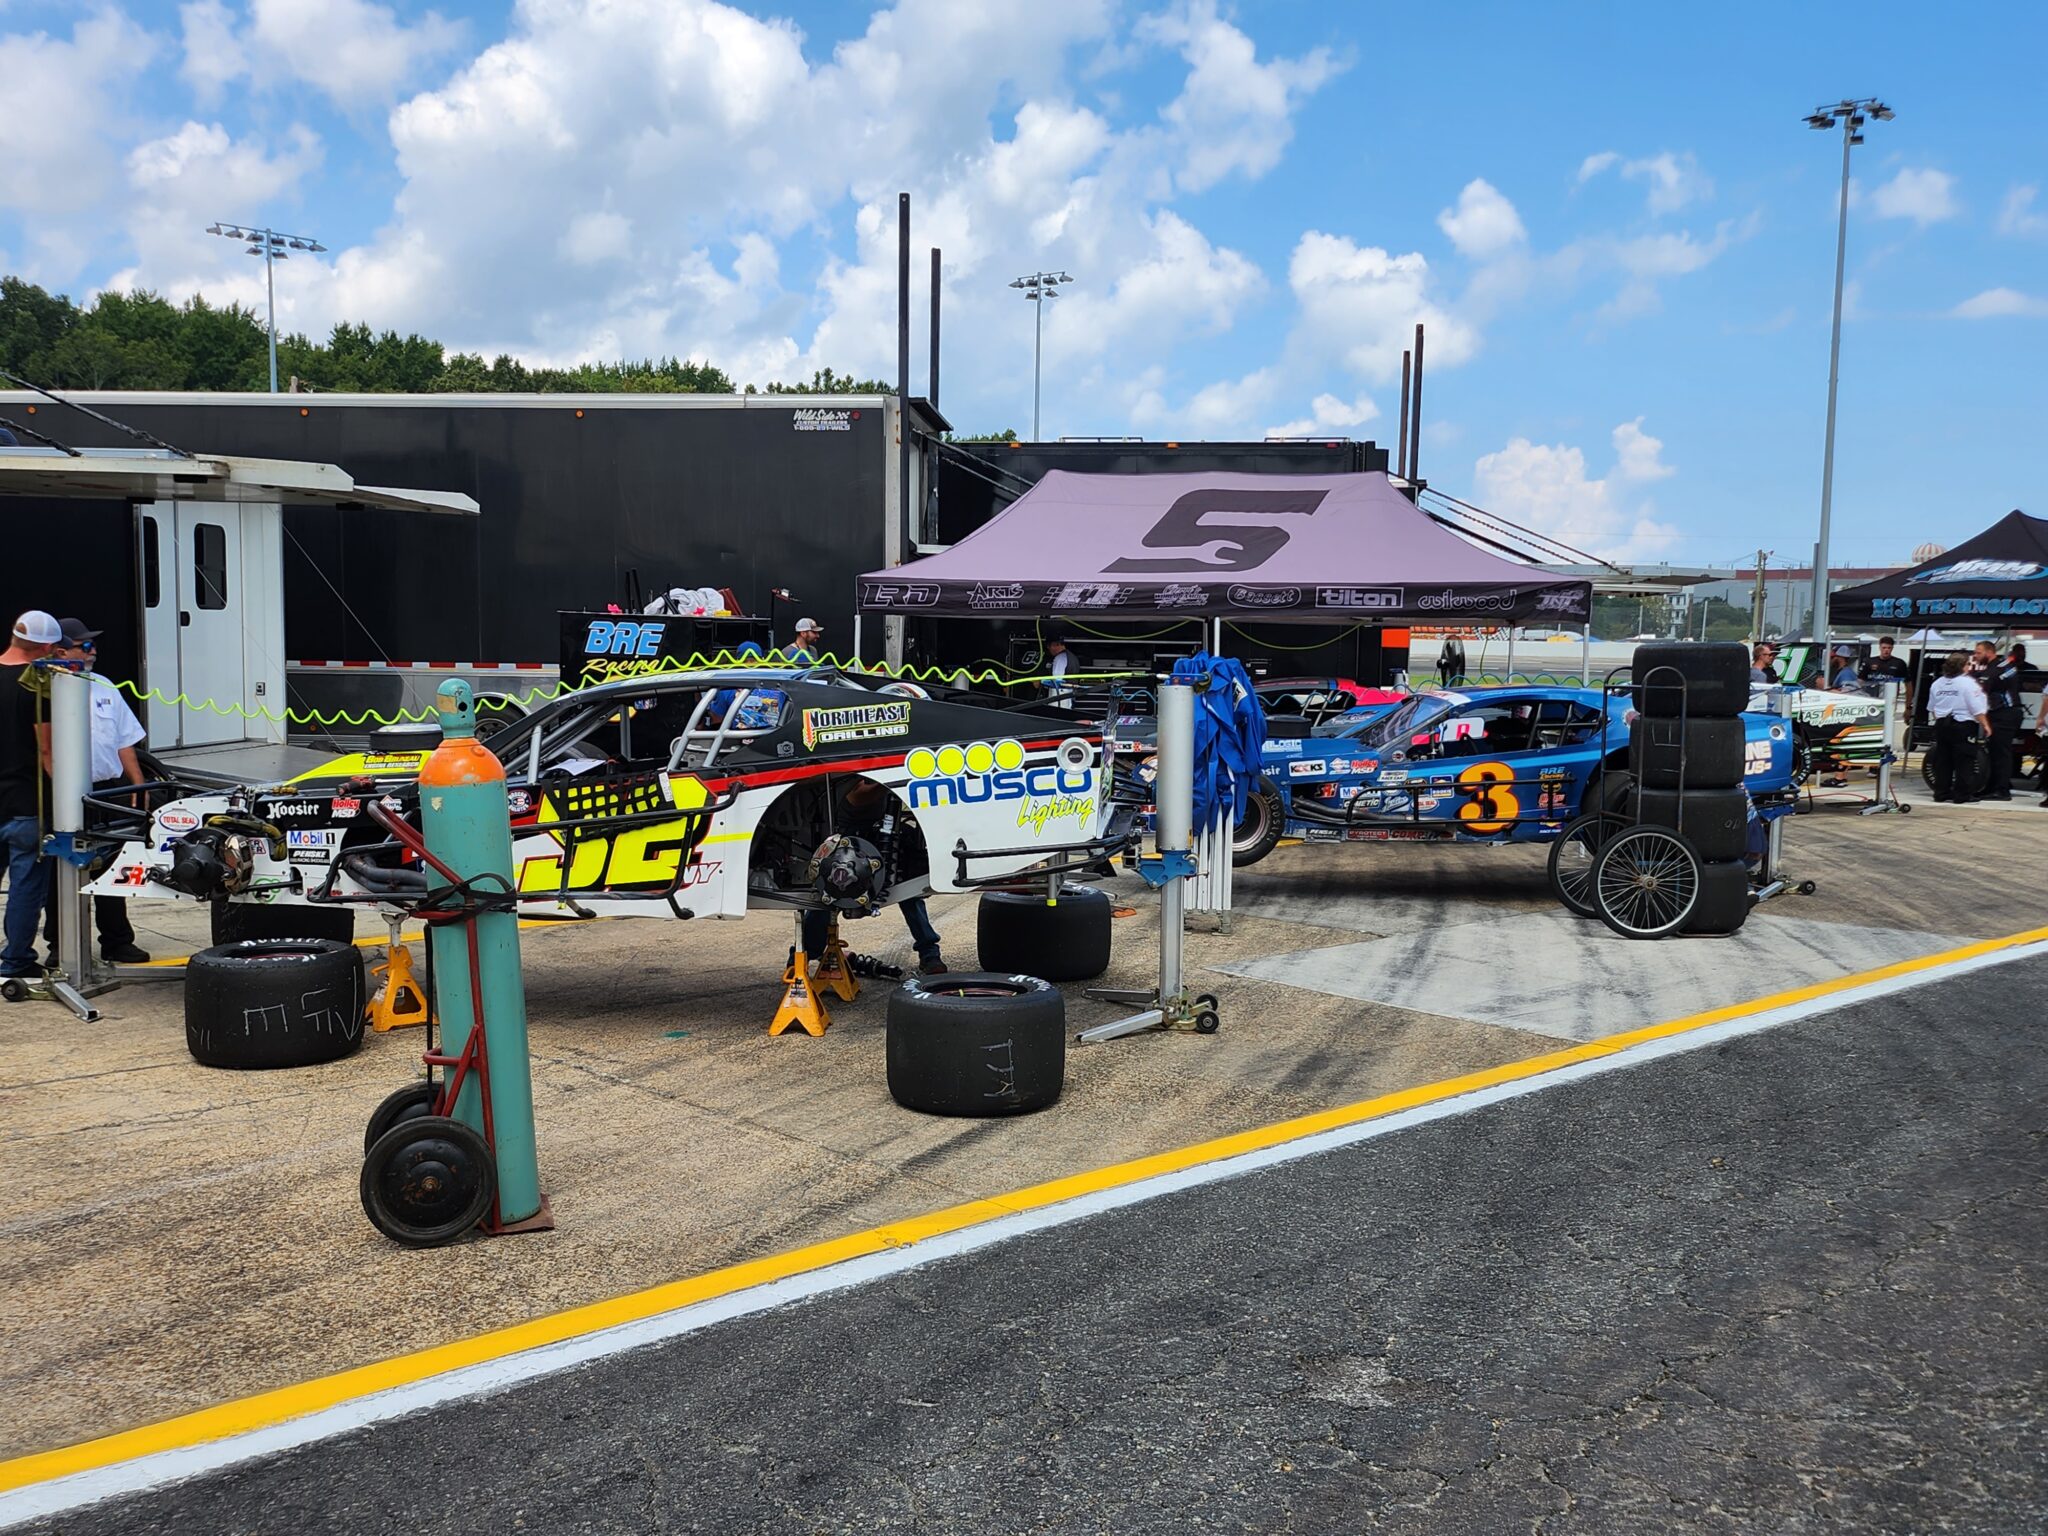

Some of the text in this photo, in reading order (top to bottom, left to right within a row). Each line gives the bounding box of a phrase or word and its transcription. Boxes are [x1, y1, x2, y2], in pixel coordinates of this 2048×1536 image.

[1322, 589, 1397, 606] tilton
[1417, 589, 1517, 611] wilwood
[1871, 597, 1912, 619] M3
[585, 621, 665, 656] BRE
[810, 703, 909, 728] NORTHEAST
[821, 725, 907, 741] DRILLING
[332, 797, 360, 809] Holley
[1344, 799, 1380, 807] CMETIC
[1458, 761, 1520, 834] 3
[266, 801, 320, 819] Hoosier
[332, 809, 357, 818] MSD
[1017, 796, 1096, 838] Lighting
[163, 815, 196, 825] TOTAL SEAL
[290, 831, 335, 844] Mobil 1
[293, 850, 326, 858] PENSKE
